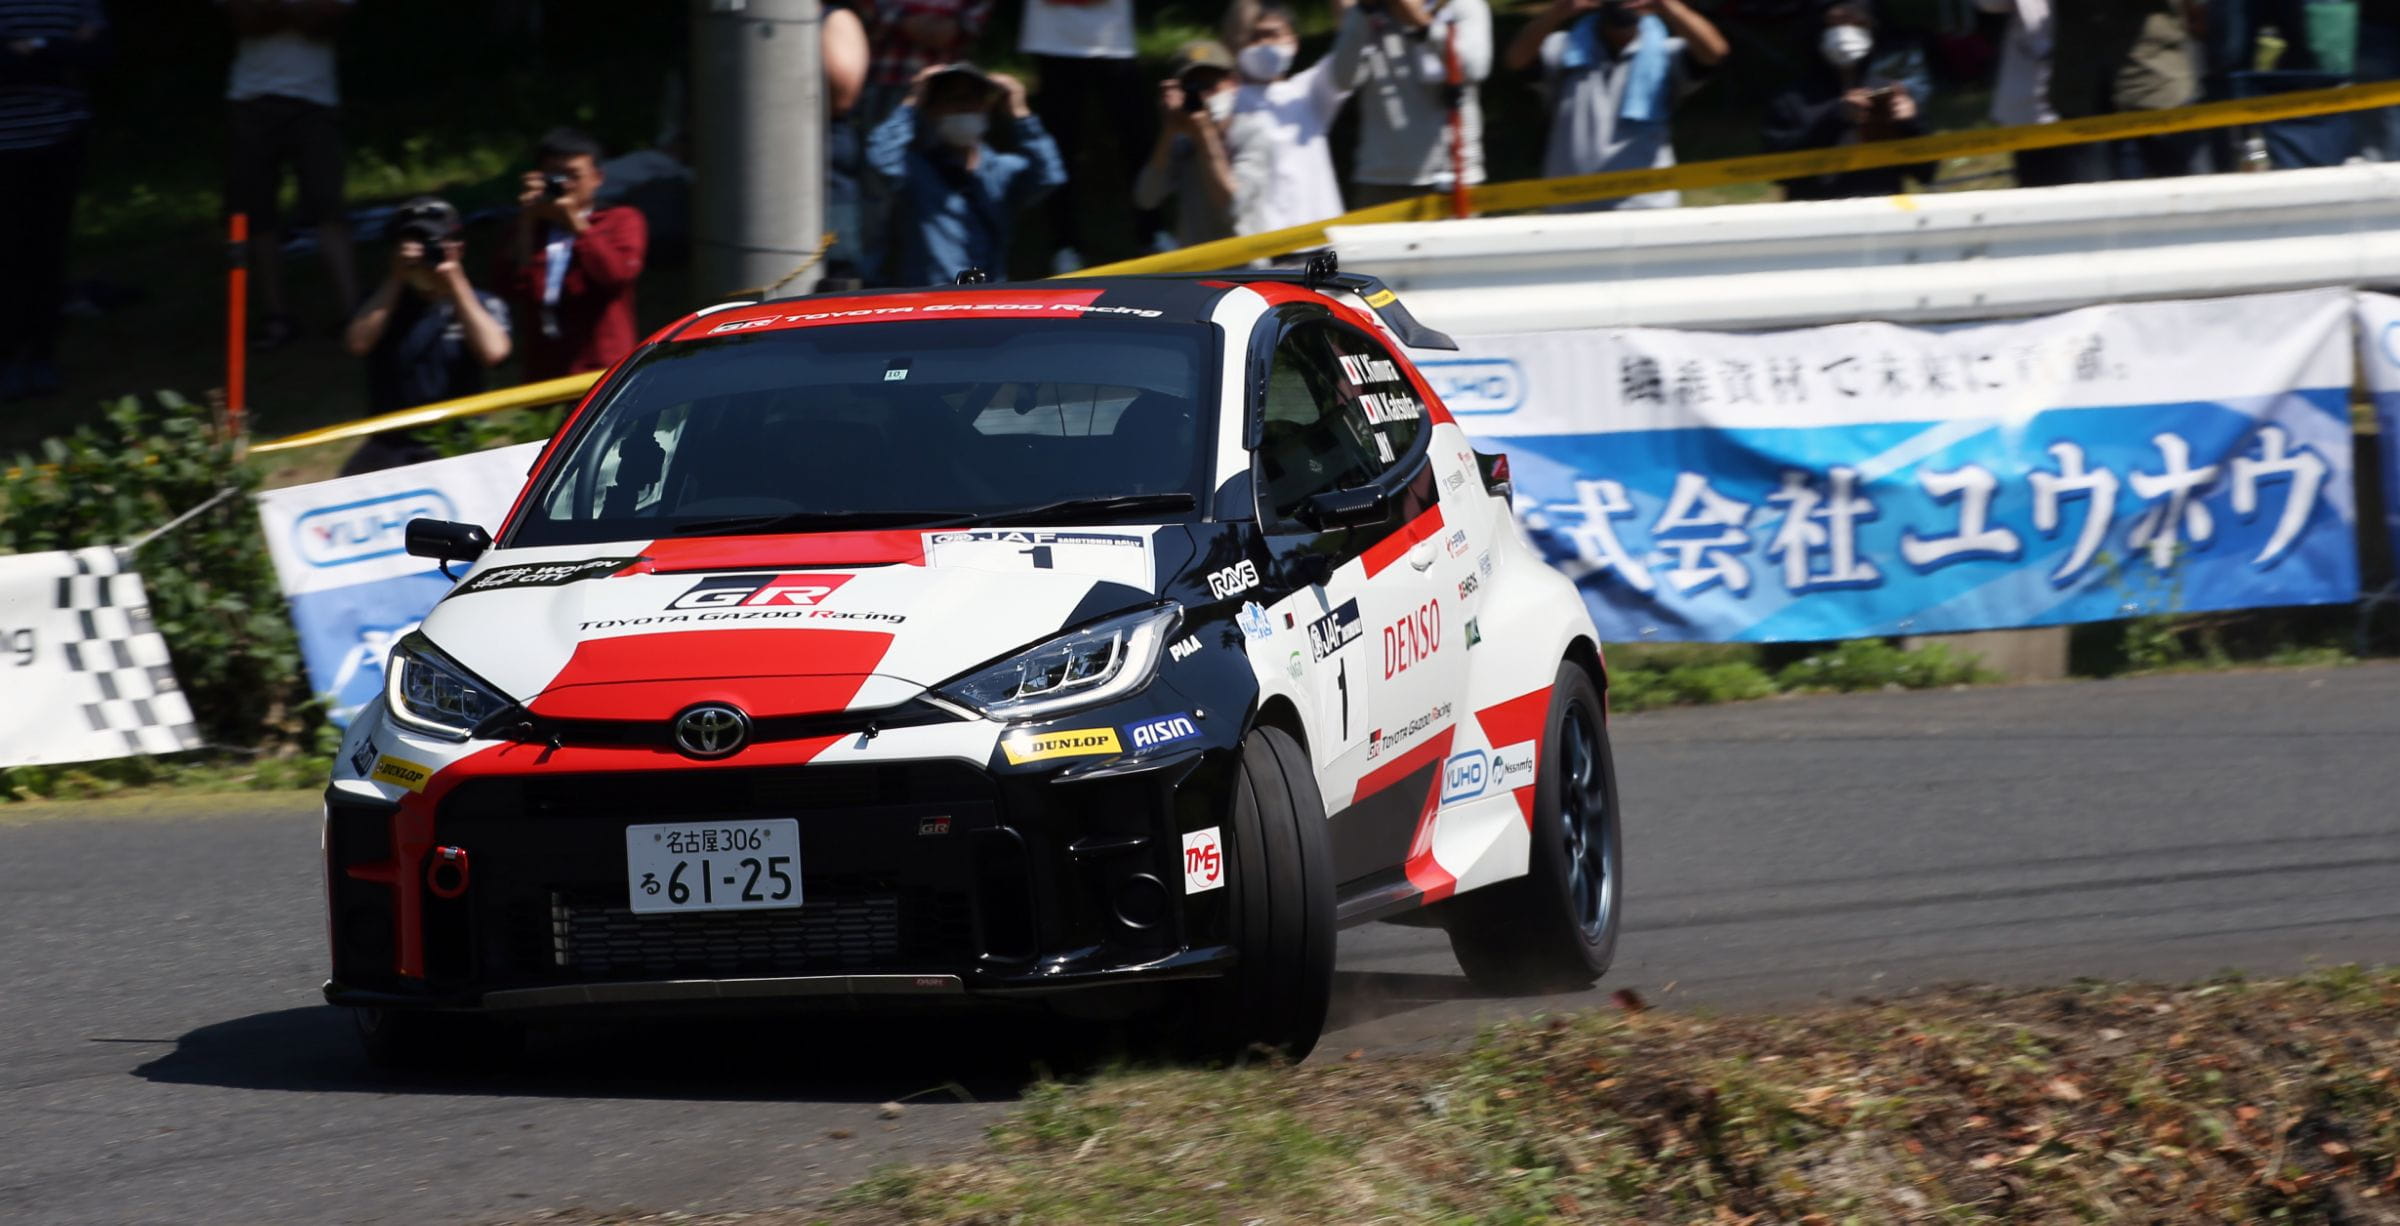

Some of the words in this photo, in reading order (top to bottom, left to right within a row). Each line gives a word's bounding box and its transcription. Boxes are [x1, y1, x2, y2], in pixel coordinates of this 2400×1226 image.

[784, 306, 914, 322] TOYOTA
[922, 304, 1044, 312] GAZOO
[1049, 303, 1164, 318] Racing
[1522, 428, 2327, 593] 式会社ユウホウ
[978, 532, 1057, 544] JAF
[1018, 545, 1054, 570] 1
[518, 572, 574, 583] CITY
[1208, 559, 1260, 600] RAYS
[674, 585, 833, 609] GR
[578, 614, 689, 631] TOYOTA
[697, 611, 802, 621] GAZOO
[808, 610, 907, 625] Racing
[1321, 612, 1343, 655] JAF
[1168, 634, 1203, 663] PIAA
[1383, 598, 1441, 681] DENSO
[1337, 656, 1349, 742] 1
[1133, 717, 1195, 748] AISIN
[1382, 726, 1408, 750] TOYOTA
[1408, 713, 1431, 737] GAZOO
[1431, 702, 1452, 721] Racing
[1032, 736, 1109, 752] DUNLOP
[382, 763, 424, 782] DUNLOP
[1446, 763, 1481, 790] YUHO
[921, 823, 948, 833] GR
[640, 872, 661, 895] る
[668, 856, 792, 904] 61-25
